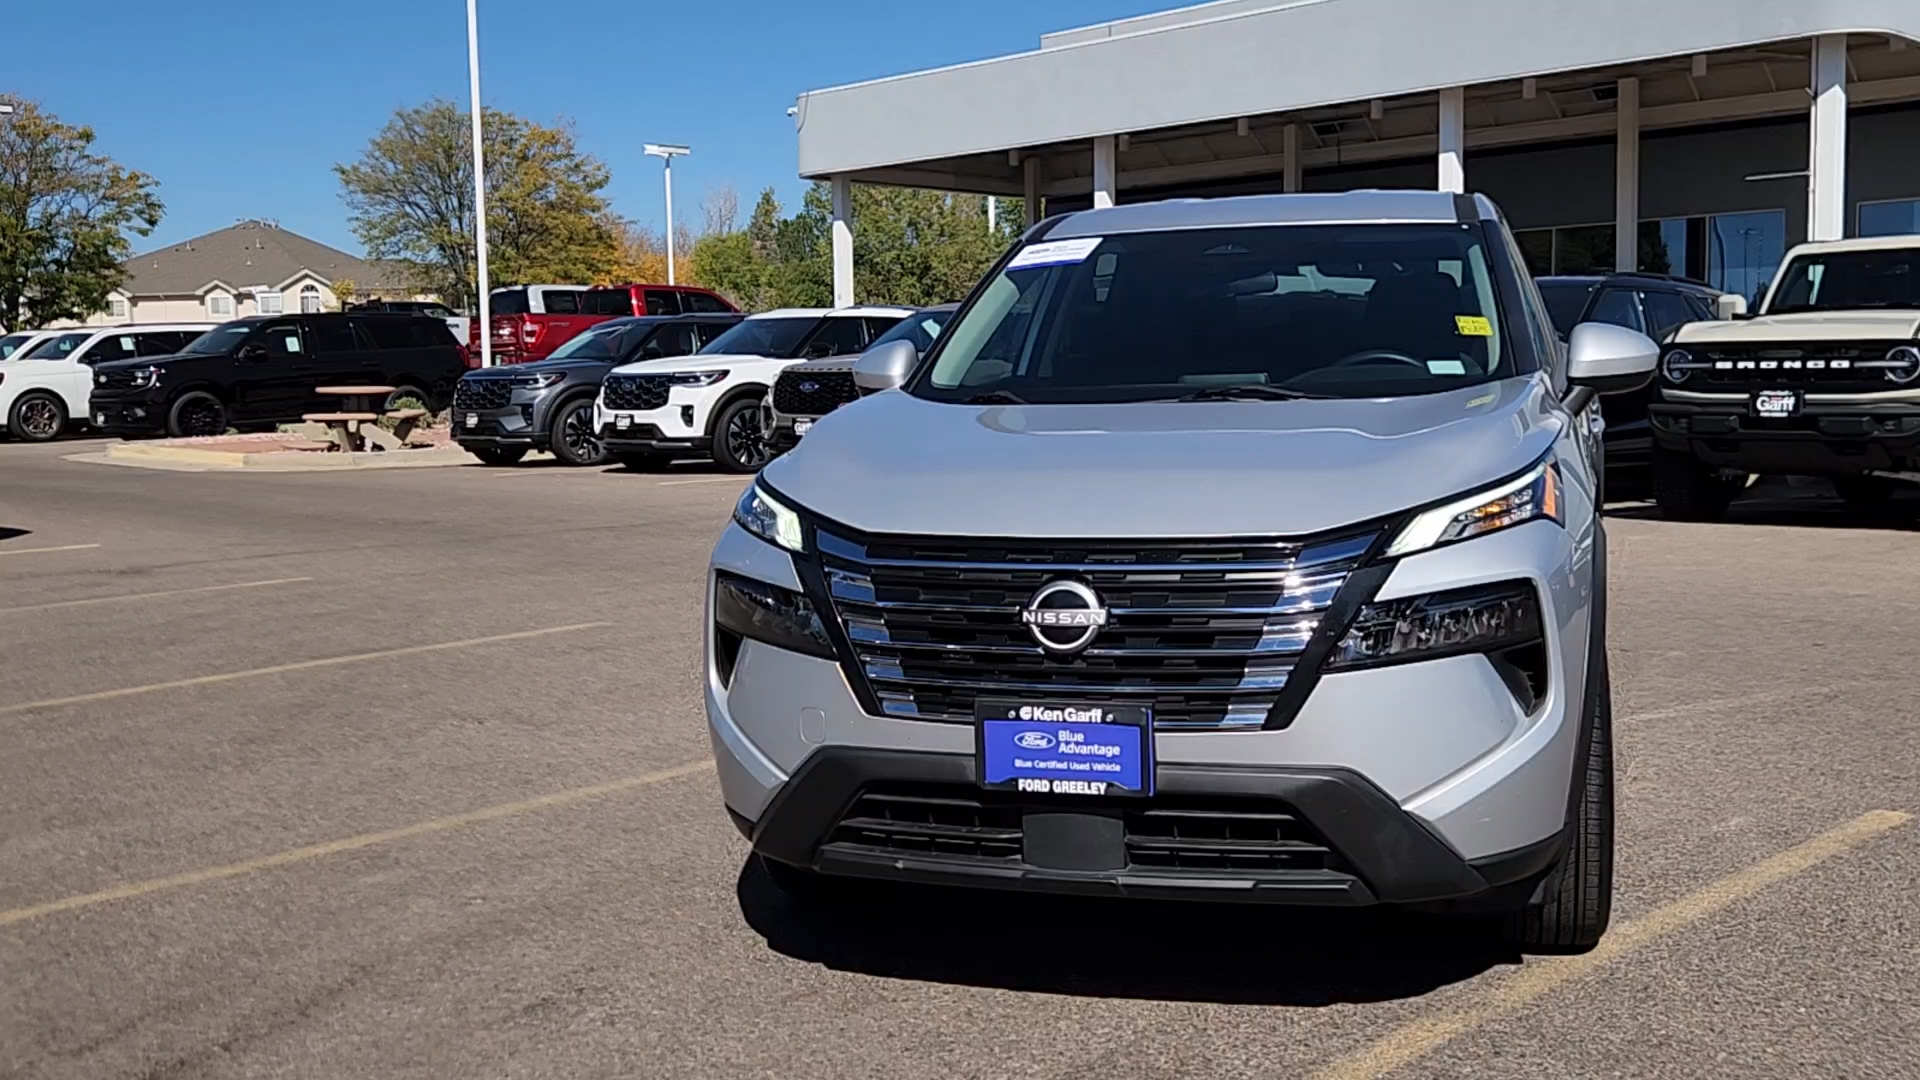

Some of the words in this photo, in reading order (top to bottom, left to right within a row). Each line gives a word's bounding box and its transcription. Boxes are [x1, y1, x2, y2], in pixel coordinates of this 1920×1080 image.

[1715, 360, 1850, 369] BRONCO
[1756, 396, 1796, 411] Garff
[1022, 611, 1104, 625] NISSAN
[1033, 707, 1063, 721] Ken
[1064, 708, 1102, 723] Garff
[1058, 730, 1085, 742] Blue
[1058, 742, 1121, 757] Advantage
[1014, 759, 1033, 768] Blue
[1034, 760, 1068, 770] Certified
[1069, 762, 1090, 771] Used
[1091, 762, 1121, 773] Vehicle
[1018, 779, 1050, 793] FORD
[1052, 780, 1107, 795] GREELEY
